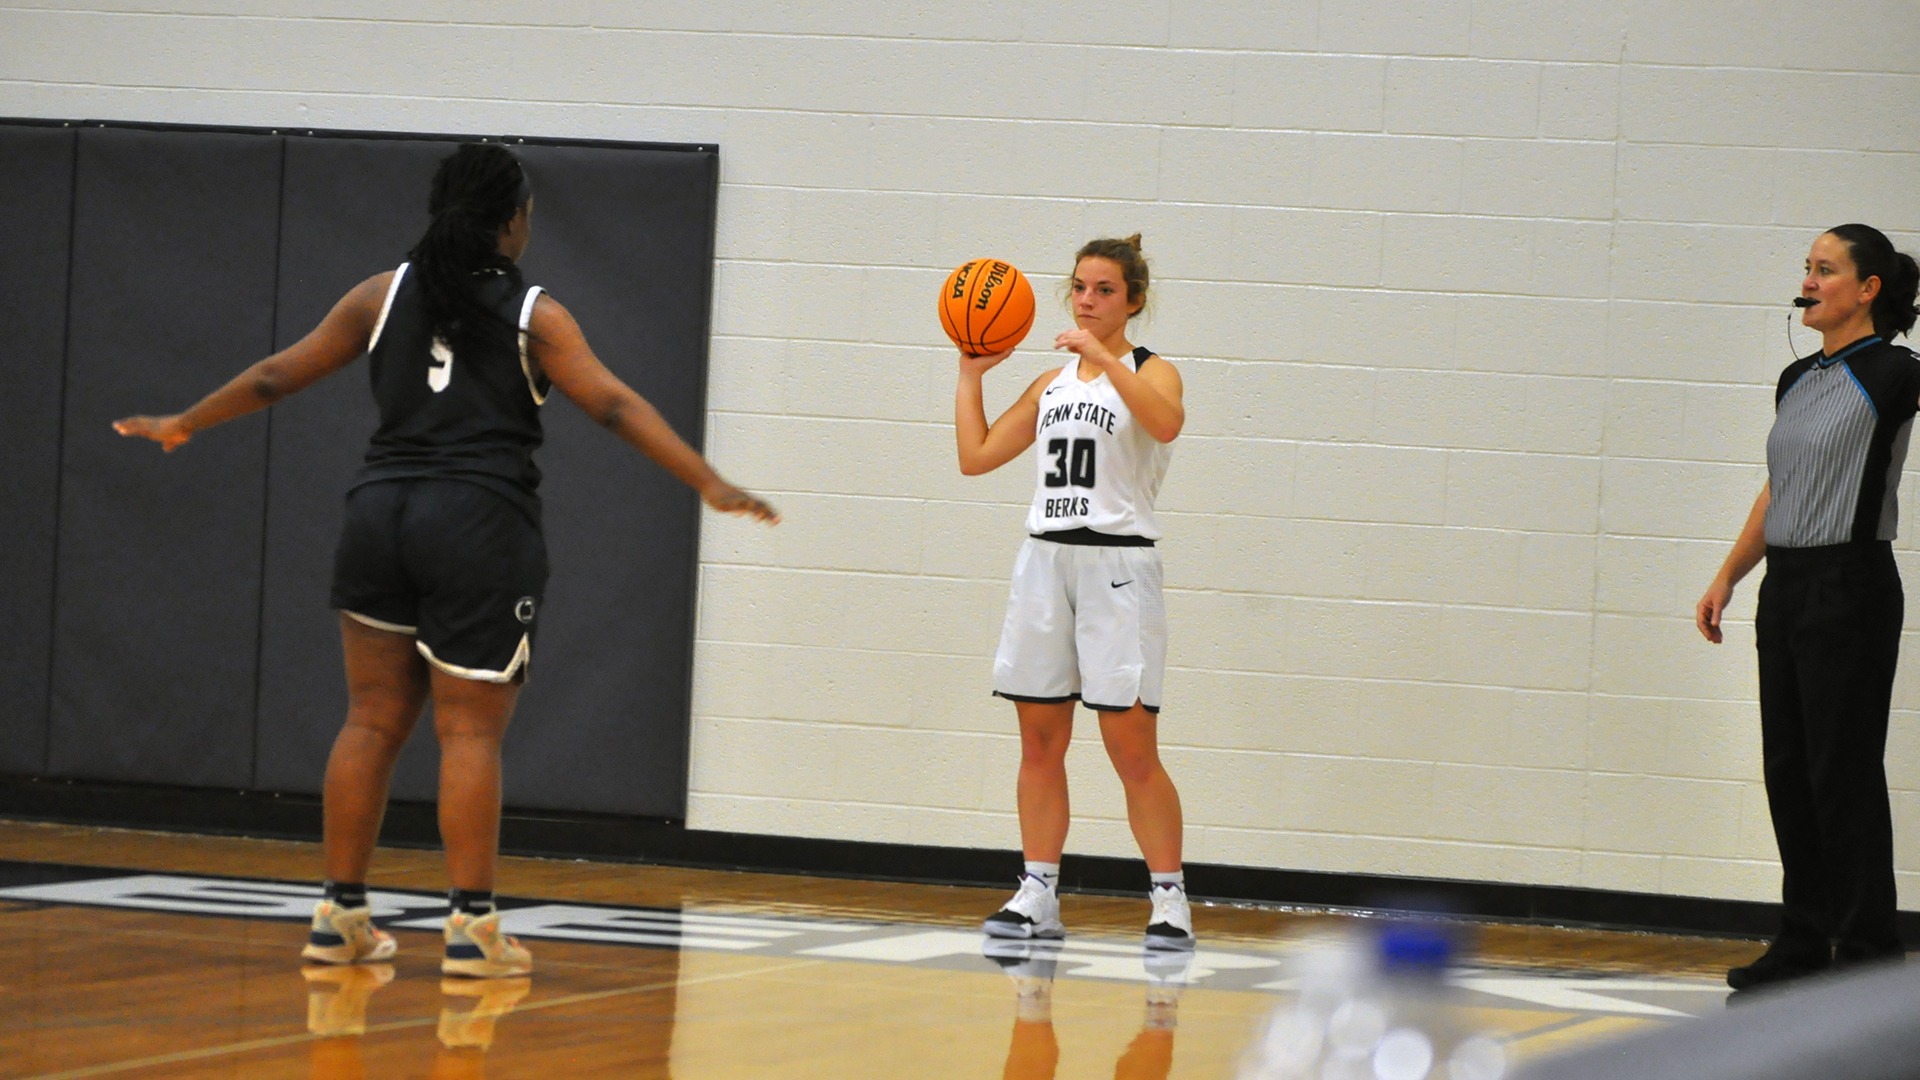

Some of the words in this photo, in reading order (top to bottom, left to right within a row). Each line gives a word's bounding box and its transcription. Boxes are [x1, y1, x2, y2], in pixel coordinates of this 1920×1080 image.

[975, 261, 1011, 311] Wilson
[1039, 402, 1074, 435] PENN
[1074, 402, 1116, 436] STATE
[1044, 437, 1096, 490] 30
[1045, 496, 1090, 518] BERKS
